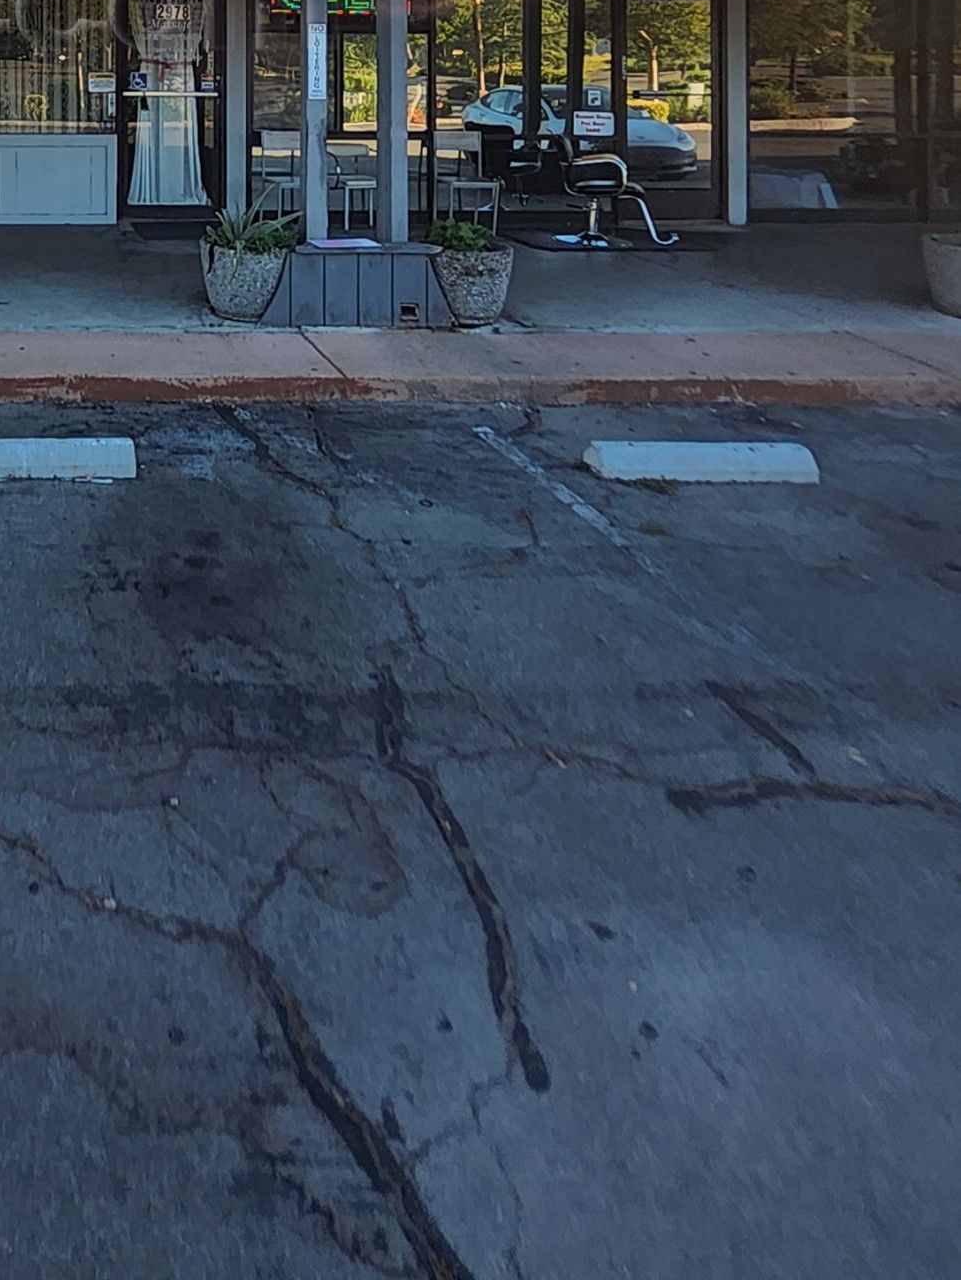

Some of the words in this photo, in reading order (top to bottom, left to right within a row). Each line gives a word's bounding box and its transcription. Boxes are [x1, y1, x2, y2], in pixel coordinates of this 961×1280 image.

[157, 4, 190, 20] 2978
[310, 24, 325, 33] NO
[313, 34, 321, 89] LOITERING
